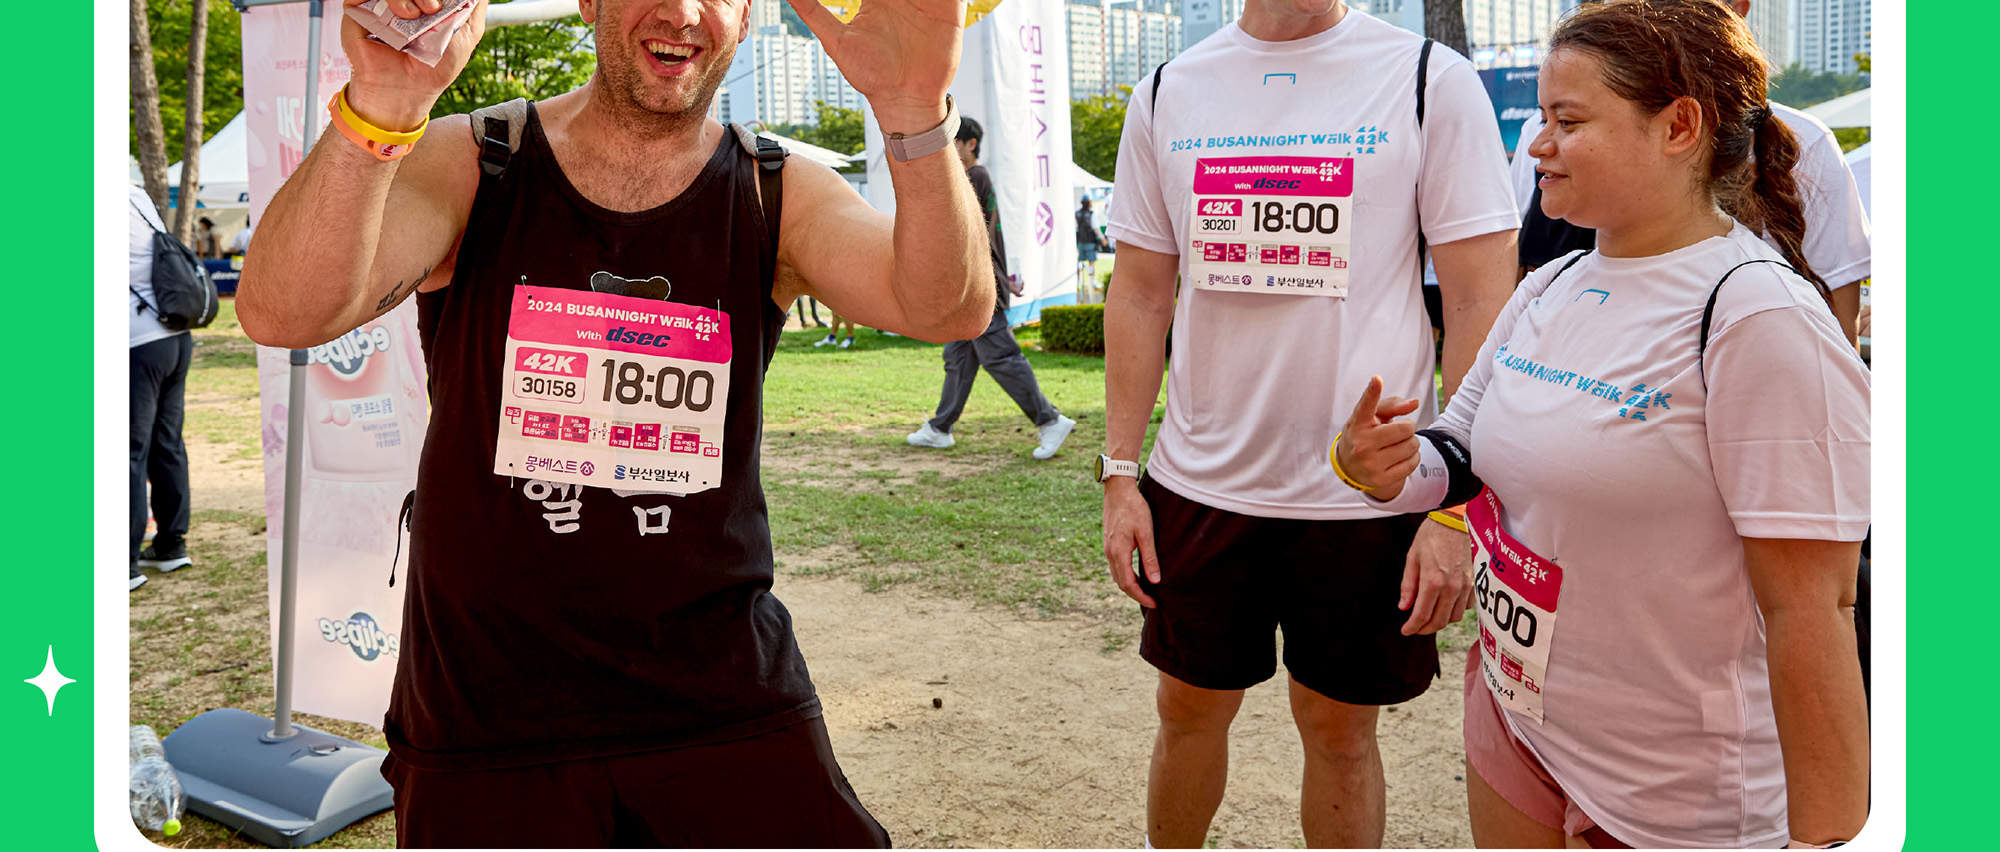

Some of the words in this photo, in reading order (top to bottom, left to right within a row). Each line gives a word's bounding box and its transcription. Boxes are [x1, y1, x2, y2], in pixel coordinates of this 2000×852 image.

[1170, 138, 1202, 152] 2024
[1204, 166, 1227, 175] 2024
[1229, 165, 1289, 174] BUSANNIGHT
[1253, 177, 1301, 190] dsec
[1202, 201, 1236, 214] 42K
[1202, 219, 1236, 231] 30201
[1251, 201, 1339, 234] 18:00
[1208, 273, 1241, 285] 몽베스트
[1277, 276, 1324, 288] 부산일보사
[527, 300, 562, 313] 2024
[566, 303, 658, 325] BUSANNIGHT
[606, 327, 671, 348] dsec
[523, 352, 577, 374] 42K
[521, 376, 577, 398] 30158
[601, 358, 715, 412] 18:00
[525, 455, 578, 473] 몽베스트
[628, 466, 690, 483] 부산일보사
